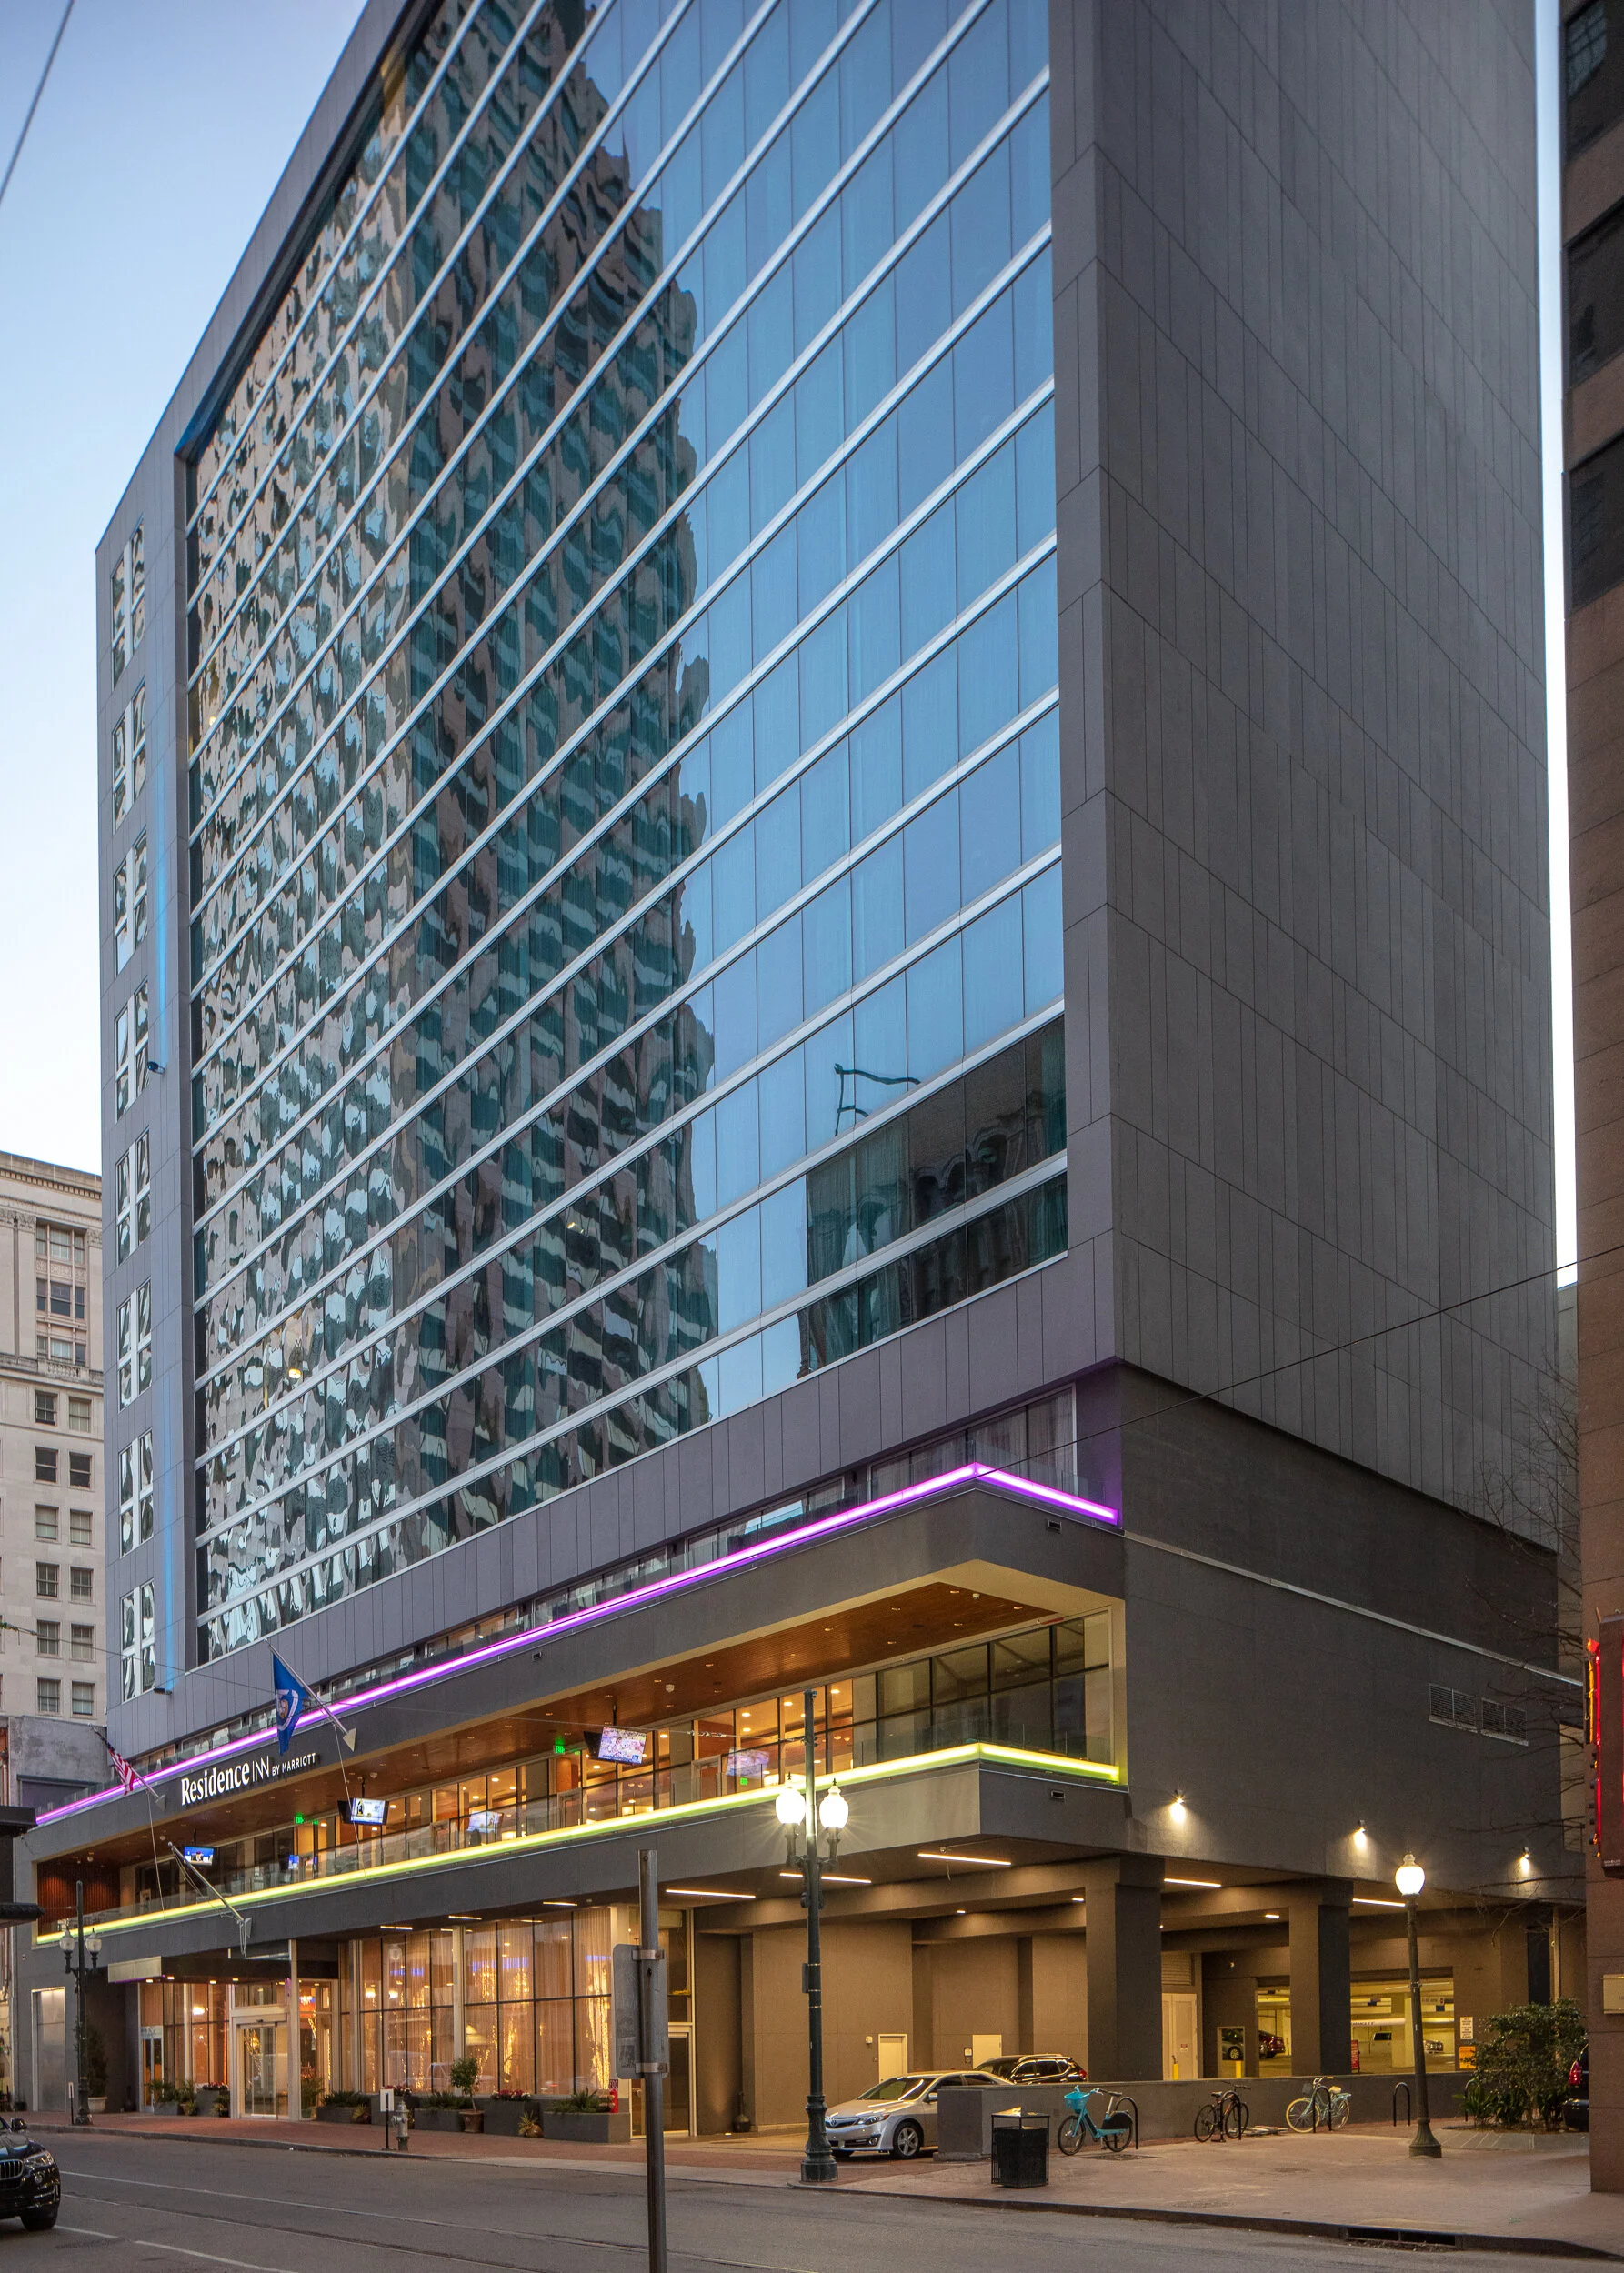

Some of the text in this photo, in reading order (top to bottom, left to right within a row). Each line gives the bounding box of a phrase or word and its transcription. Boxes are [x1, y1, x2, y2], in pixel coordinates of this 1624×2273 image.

[181, 1752, 316, 1806] Residence INN BY MARRIOTT
